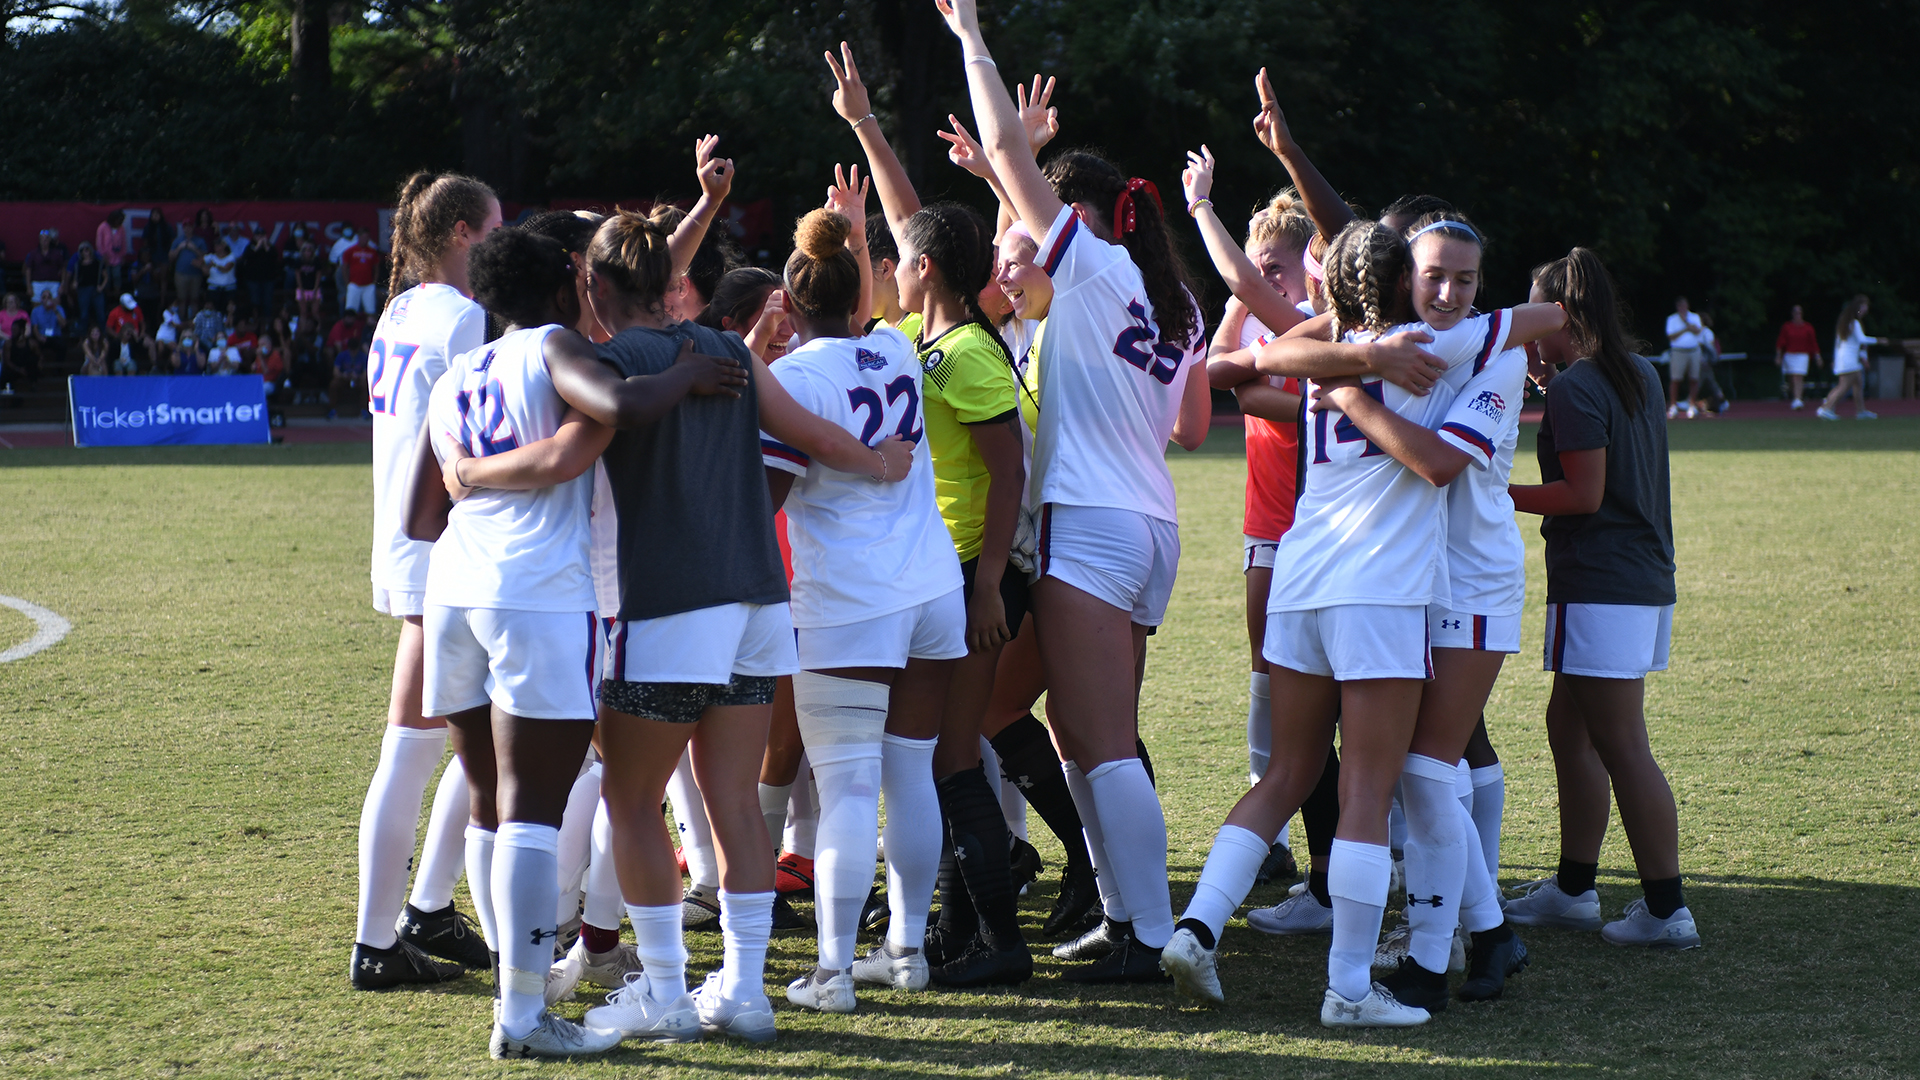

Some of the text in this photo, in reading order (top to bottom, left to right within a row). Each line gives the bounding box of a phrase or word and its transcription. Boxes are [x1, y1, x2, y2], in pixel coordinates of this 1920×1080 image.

[371, 337, 420, 417] 27
[846, 374, 924, 449] 22
[78, 401, 263, 429] TicketSmarter
